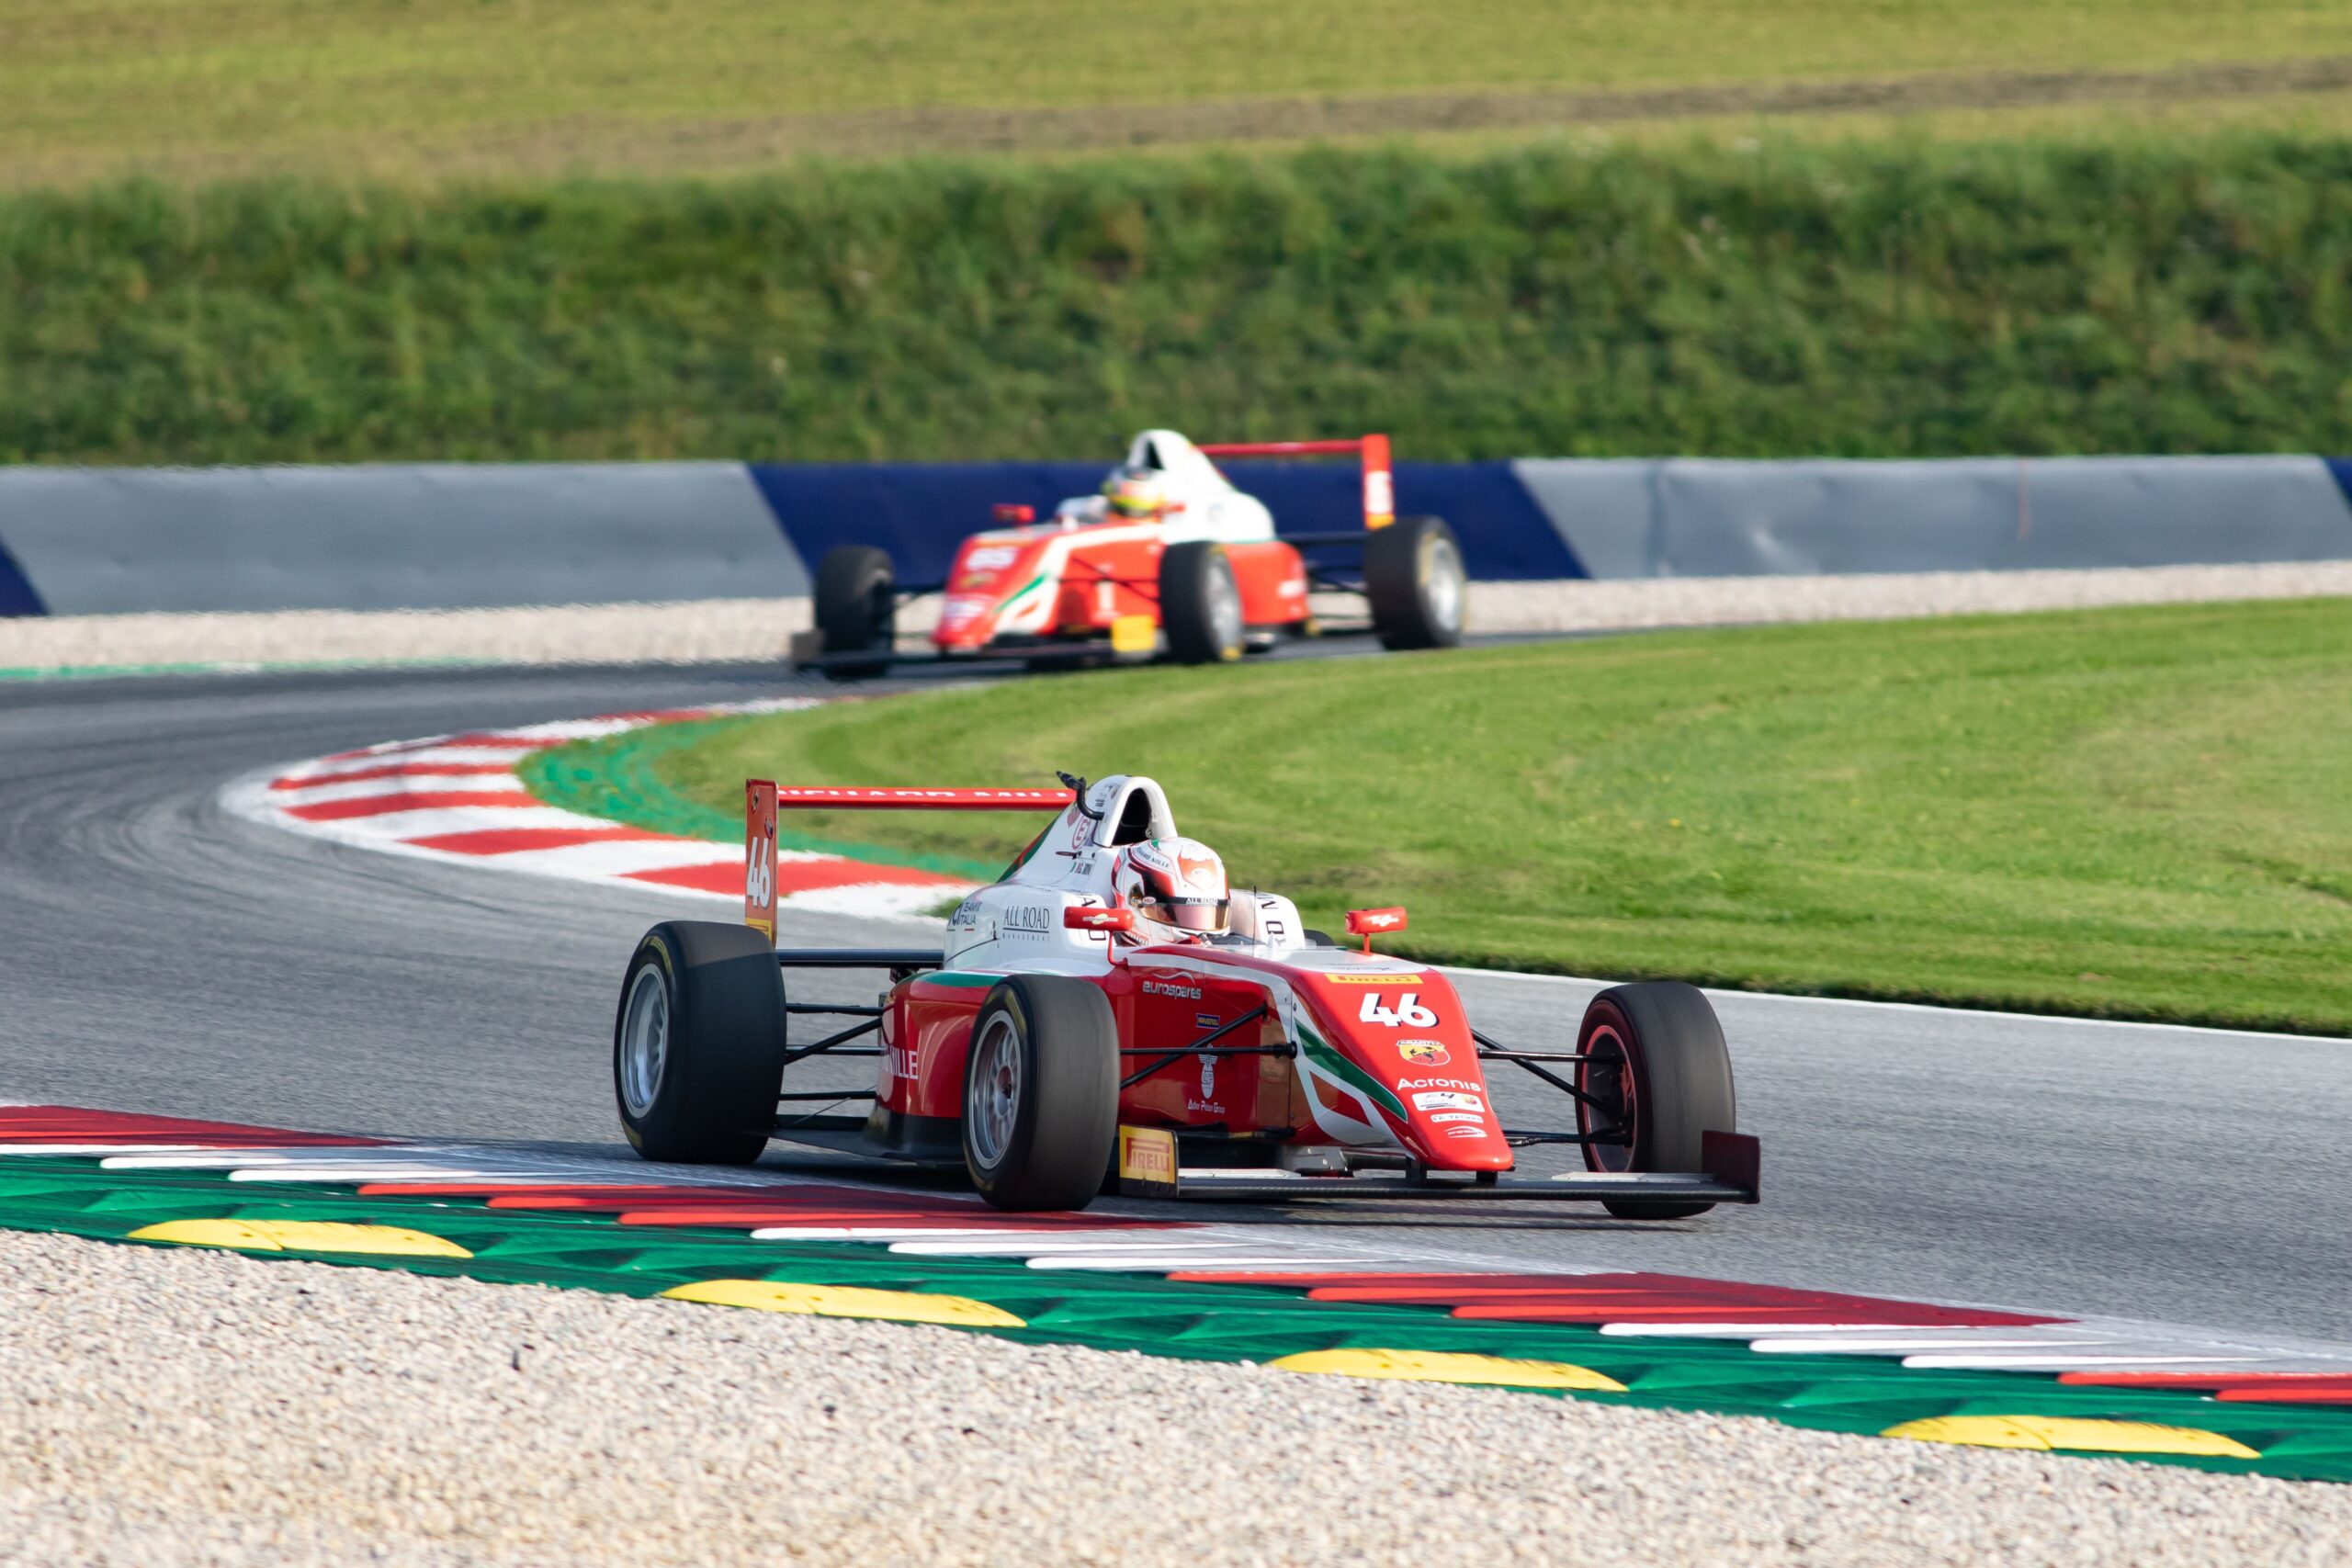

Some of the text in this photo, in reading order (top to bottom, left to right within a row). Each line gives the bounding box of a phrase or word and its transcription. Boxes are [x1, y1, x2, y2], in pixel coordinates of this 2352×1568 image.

[747, 836, 771, 908] 46
[1003, 906, 1051, 930] ALL ROAD
[1143, 980, 1202, 999] eurospares
[1359, 993, 1439, 1028] 46
[1397, 1077, 1482, 1092] Acronis
[1126, 1136, 1170, 1173] PIRELLI
